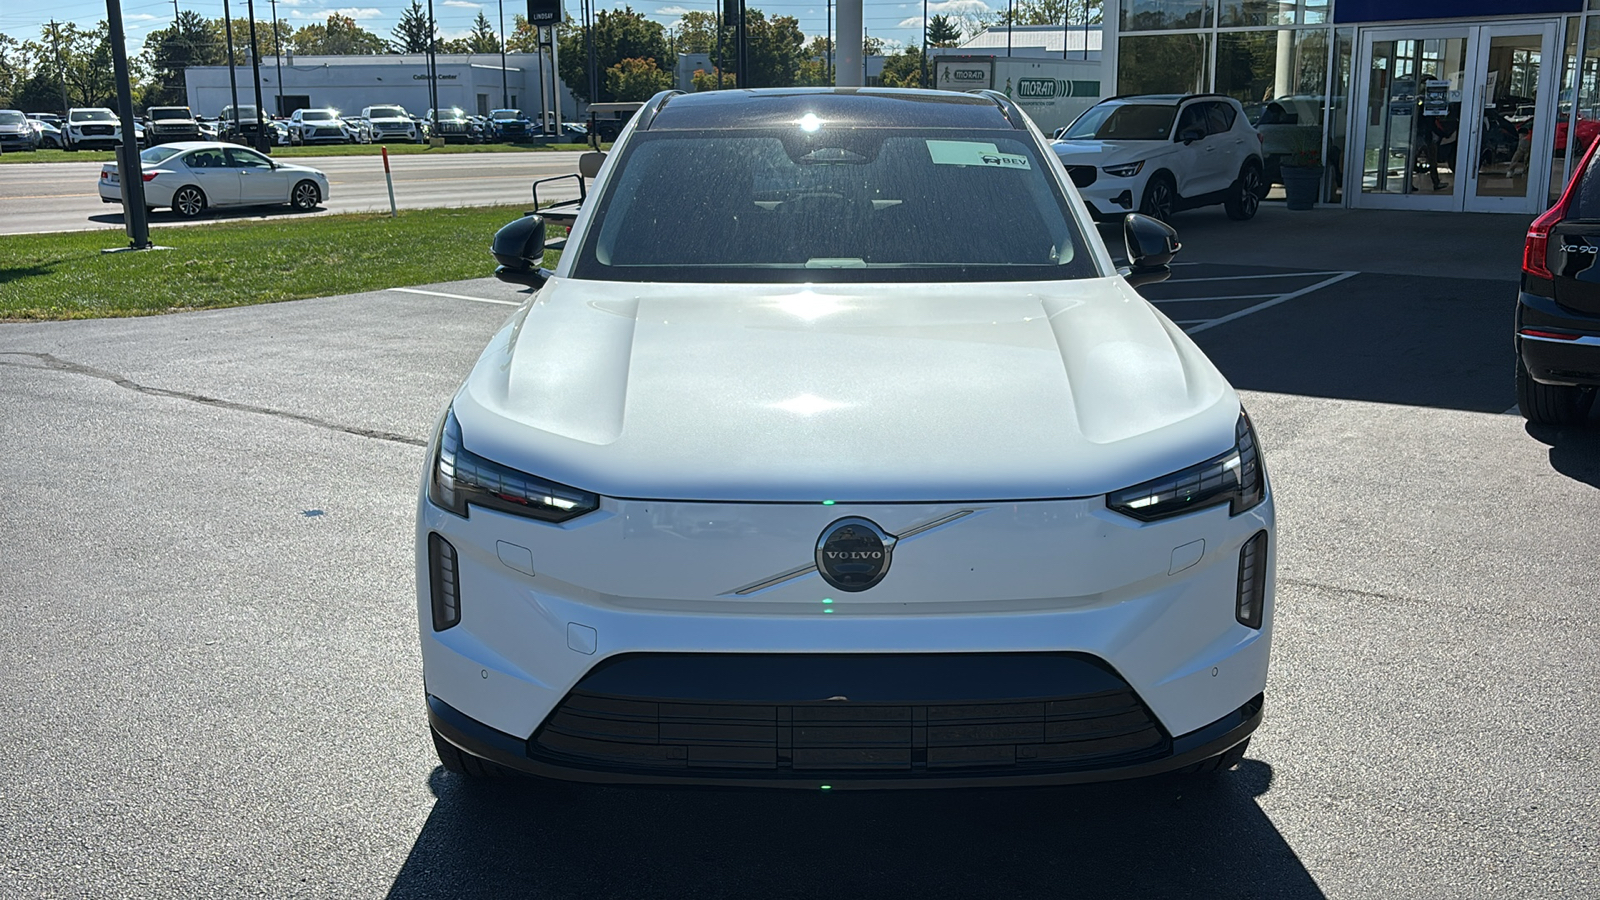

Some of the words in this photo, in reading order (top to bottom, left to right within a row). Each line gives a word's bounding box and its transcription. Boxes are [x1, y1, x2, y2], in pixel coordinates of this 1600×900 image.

[533, 12, 553, 20] LINDSAY
[955, 70, 983, 79] MORAN
[1020, 80, 1054, 96] MORAN
[1002, 157, 1026, 165] BEV
[826, 551, 882, 559] VOLVO
